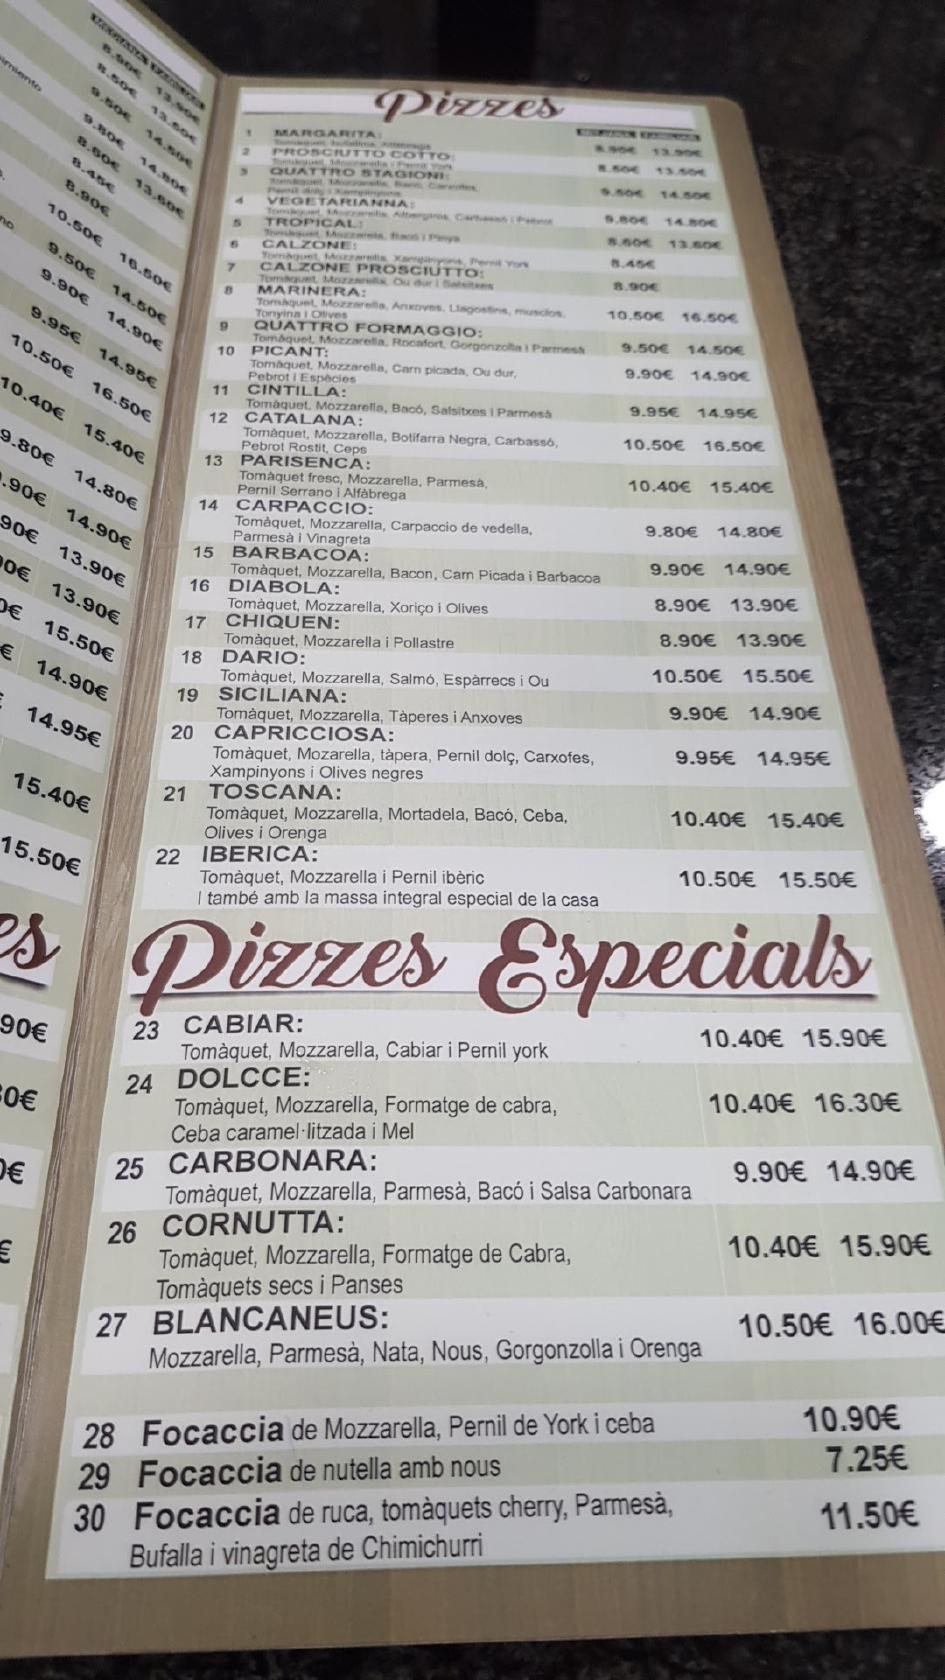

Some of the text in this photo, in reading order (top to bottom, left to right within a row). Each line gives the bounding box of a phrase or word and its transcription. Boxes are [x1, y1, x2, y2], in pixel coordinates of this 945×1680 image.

[374, 88, 564, 124] Pizzes
[48, 203, 104, 247] 10.50€
[262, 240, 356, 250] CALZONE:
[119, 252, 173, 293] 16.50€
[259, 262, 484, 278] CALZONE PROSCIUTTO:
[41, 268, 90, 306] 9.90€
[224, 285, 365, 297] 8 MARINERA:
[613, 281, 659, 292] 8.90€
[31, 305, 82, 344] 9.95€
[220, 319, 483, 338] 9 QUATTRO FORMAGGIO:
[608, 311, 738, 324] 10.50€ 16.50€
[107, 310, 164, 351] 14.90€
[11, 334, 75, 378] 10.50€
[252, 346, 328, 358] PICANT:
[213, 384, 346, 398] 11 CINTILLA:
[245, 398, 311, 411] Tomàquet,
[316, 401, 387, 414] Mozzarella,
[392, 403, 426, 415] Bacó,
[432, 405, 486, 416] Salsitxes
[497, 408, 552, 418] Parmesà
[245, 412, 362, 426] CATALANA:
[630, 406, 758, 419] 9.95€ 14.95€
[84, 424, 146, 464] 15.40€
[205, 454, 370, 470] 13 PARISENCA:
[74, 470, 139, 510] 14.80€
[238, 484, 276, 495] Pernil
[281, 486, 332, 497] Serrano
[343, 488, 406, 501] Alfàbrega
[629, 480, 774, 493] 10.40€ 15.40€
[236, 499, 373, 515] CARPACCIO:
[194, 546, 368, 562] 15 BARBACOA:
[59, 546, 127, 588] 13.90€
[650, 563, 791, 576] 9.90€ 14.90€
[229, 579, 339, 595] DIABOLA:
[229, 598, 299, 613] Tomàquet,
[306, 600, 384, 614] Mozzarella,
[390, 601, 433, 616] Xoriço
[446, 603, 488, 614] Olives
[185, 613, 339, 630] 17 CHIQUEN:
[45, 620, 116, 662] 15.50€
[223, 649, 305, 665] DARIO:
[652, 669, 814, 683] 10.50€ 15.50€
[219, 687, 346, 704] SICILIANA:
[27, 707, 103, 749] 14.95€
[171, 725, 394, 742] 20 CAPRICCIOSA:
[676, 750, 831, 766] 9.95€ 14.95€
[210, 765, 305, 782] Xampinyons
[320, 766, 366, 779] Olives
[372, 769, 423, 782] negres
[13, 772, 92, 813] 15.40€
[209, 783, 341, 800] TOSCANA:
[671, 811, 844, 829] 10.40€ 15.40€
[1, 835, 81, 876] 15.50€
[156, 845, 317, 865] 22 IBERICA:
[679, 871, 857, 888] 10.50€ 15.50€
[131, 914, 871, 1019] Pizzes Especials
[133, 1014, 303, 1040] 23 CABIAR:
[701, 1028, 887, 1048] 10.40€ 15.90€
[180, 1043, 271, 1063] Tomàquet,
[280, 1041, 378, 1061] Mozzarella,
[386, 1041, 443, 1058] Cabiar
[458, 1042, 506, 1058] Pernil
[513, 1042, 548, 1063] york
[125, 1067, 310, 1095] 24 DOLCCE:
[709, 1092, 902, 1114] 10.40€ 16.30€
[115, 1149, 376, 1180] 25 CARBONARA:
[733, 1159, 916, 1183] 9.90€ 14.90€
[107, 1210, 343, 1244] 26 CORNUTTA:
[728, 1234, 932, 1258] 10.40€ 15.90€
[96, 1305, 388, 1338] 27 BLANCANEUS:
[739, 1310, 945, 1338] 10.50€ 16.00€
[149, 1344, 261, 1369] Mozzarella,
[270, 1341, 364, 1366] Parmesà,
[373, 1341, 424, 1365] Nata,
[433, 1340, 488, 1363] Nous,
[496, 1338, 613, 1365] Gorgonzolla
[630, 1337, 702, 1363] Orenga
[803, 1404, 901, 1432] 10.90€
[82, 1422, 115, 1449] 28
[143, 1416, 284, 1447] Focaccia
[291, 1418, 318, 1441] de
[325, 1416, 440, 1441] Mozzarella,
[450, 1414, 506, 1437] Pernil
[514, 1414, 538, 1436] de
[545, 1413, 589, 1435] York
[606, 1412, 655, 1434] ceba
[826, 1444, 909, 1473] 7.25€
[78, 1455, 501, 1491] 29 Focaccia de nutella amb nous
[74, 1491, 672, 1533] 30 Focaccia de ruca, tomàquets cherry, Parmesà,
[821, 1500, 920, 1530] 11.50€
[130, 1543, 202, 1568] Bufalla
[222, 1539, 320, 1569] vinagreta
[328, 1536, 354, 1561] de
[362, 1532, 482, 1560] Chimichurri
